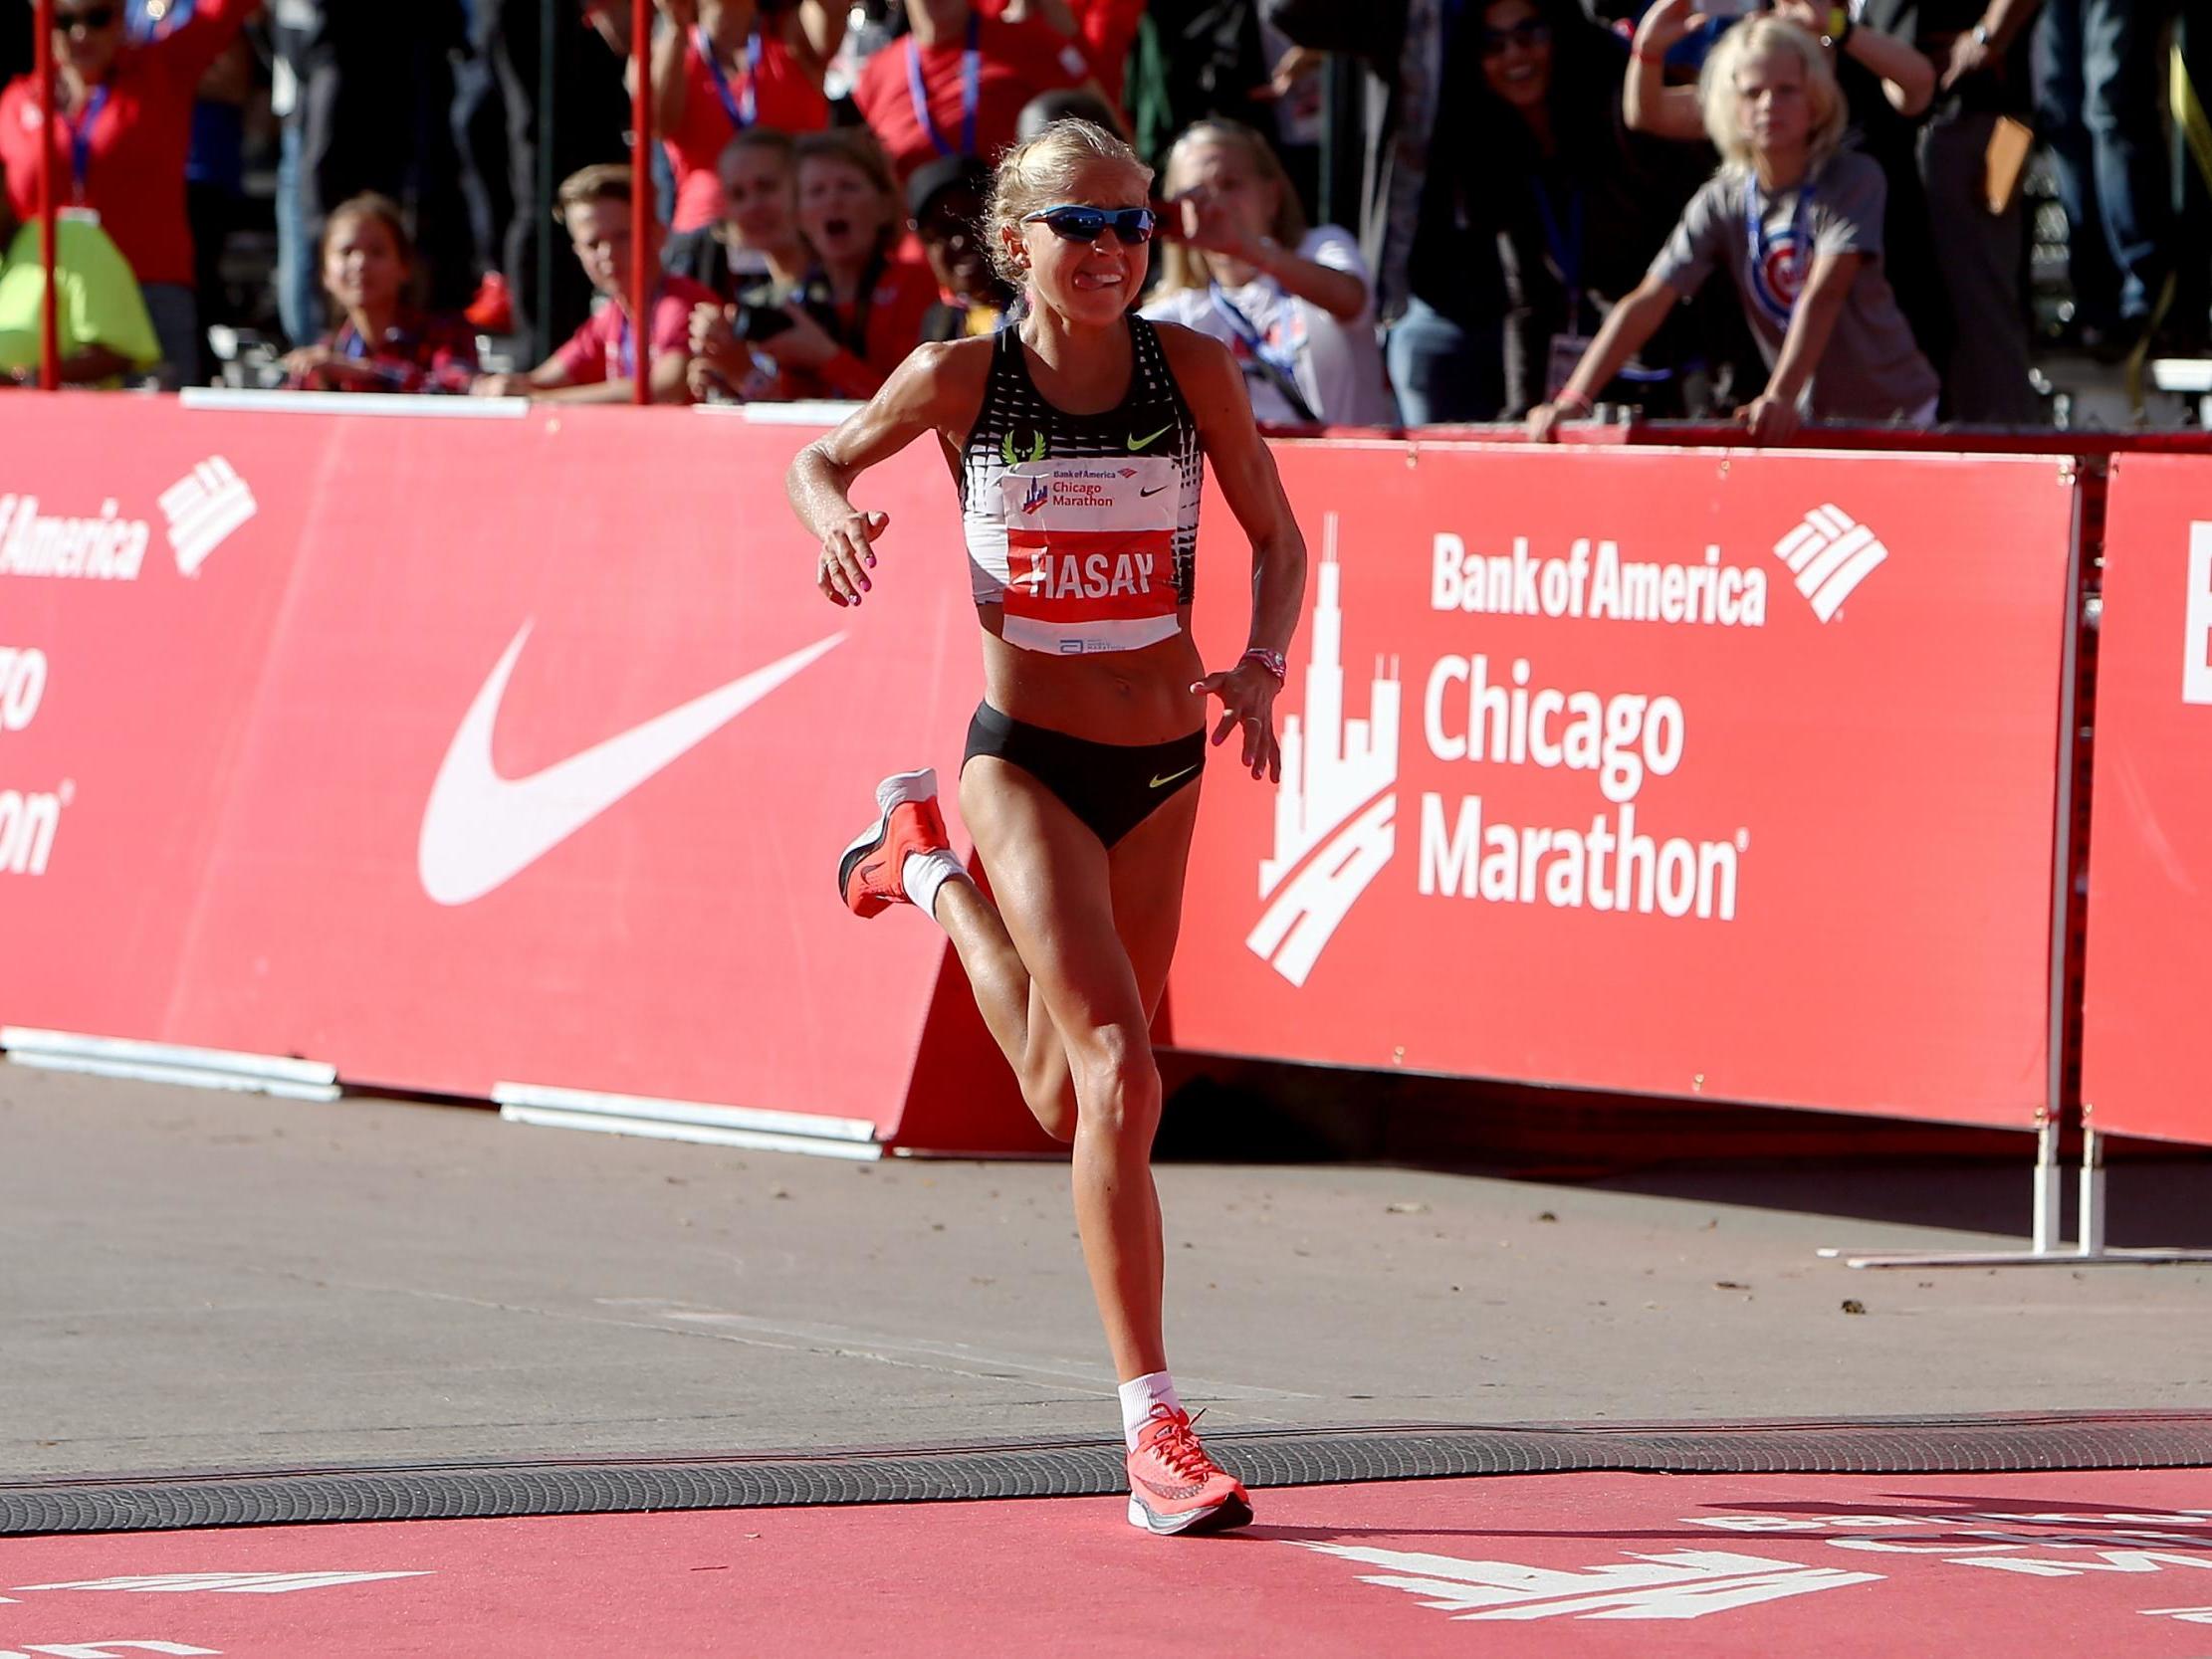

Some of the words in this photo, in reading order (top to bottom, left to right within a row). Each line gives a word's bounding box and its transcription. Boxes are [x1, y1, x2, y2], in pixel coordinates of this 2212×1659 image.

[1052, 481, 1102, 496] Chicago
[1053, 470, 1074, 479] Bank
[1052, 495, 1113, 507] Marathon
[1028, 552, 1155, 599] HASAY
[1431, 532, 1540, 615] Bank
[1541, 537, 1590, 617] of
[1589, 539, 1768, 627] America
[1424, 654, 1685, 803] Chicago
